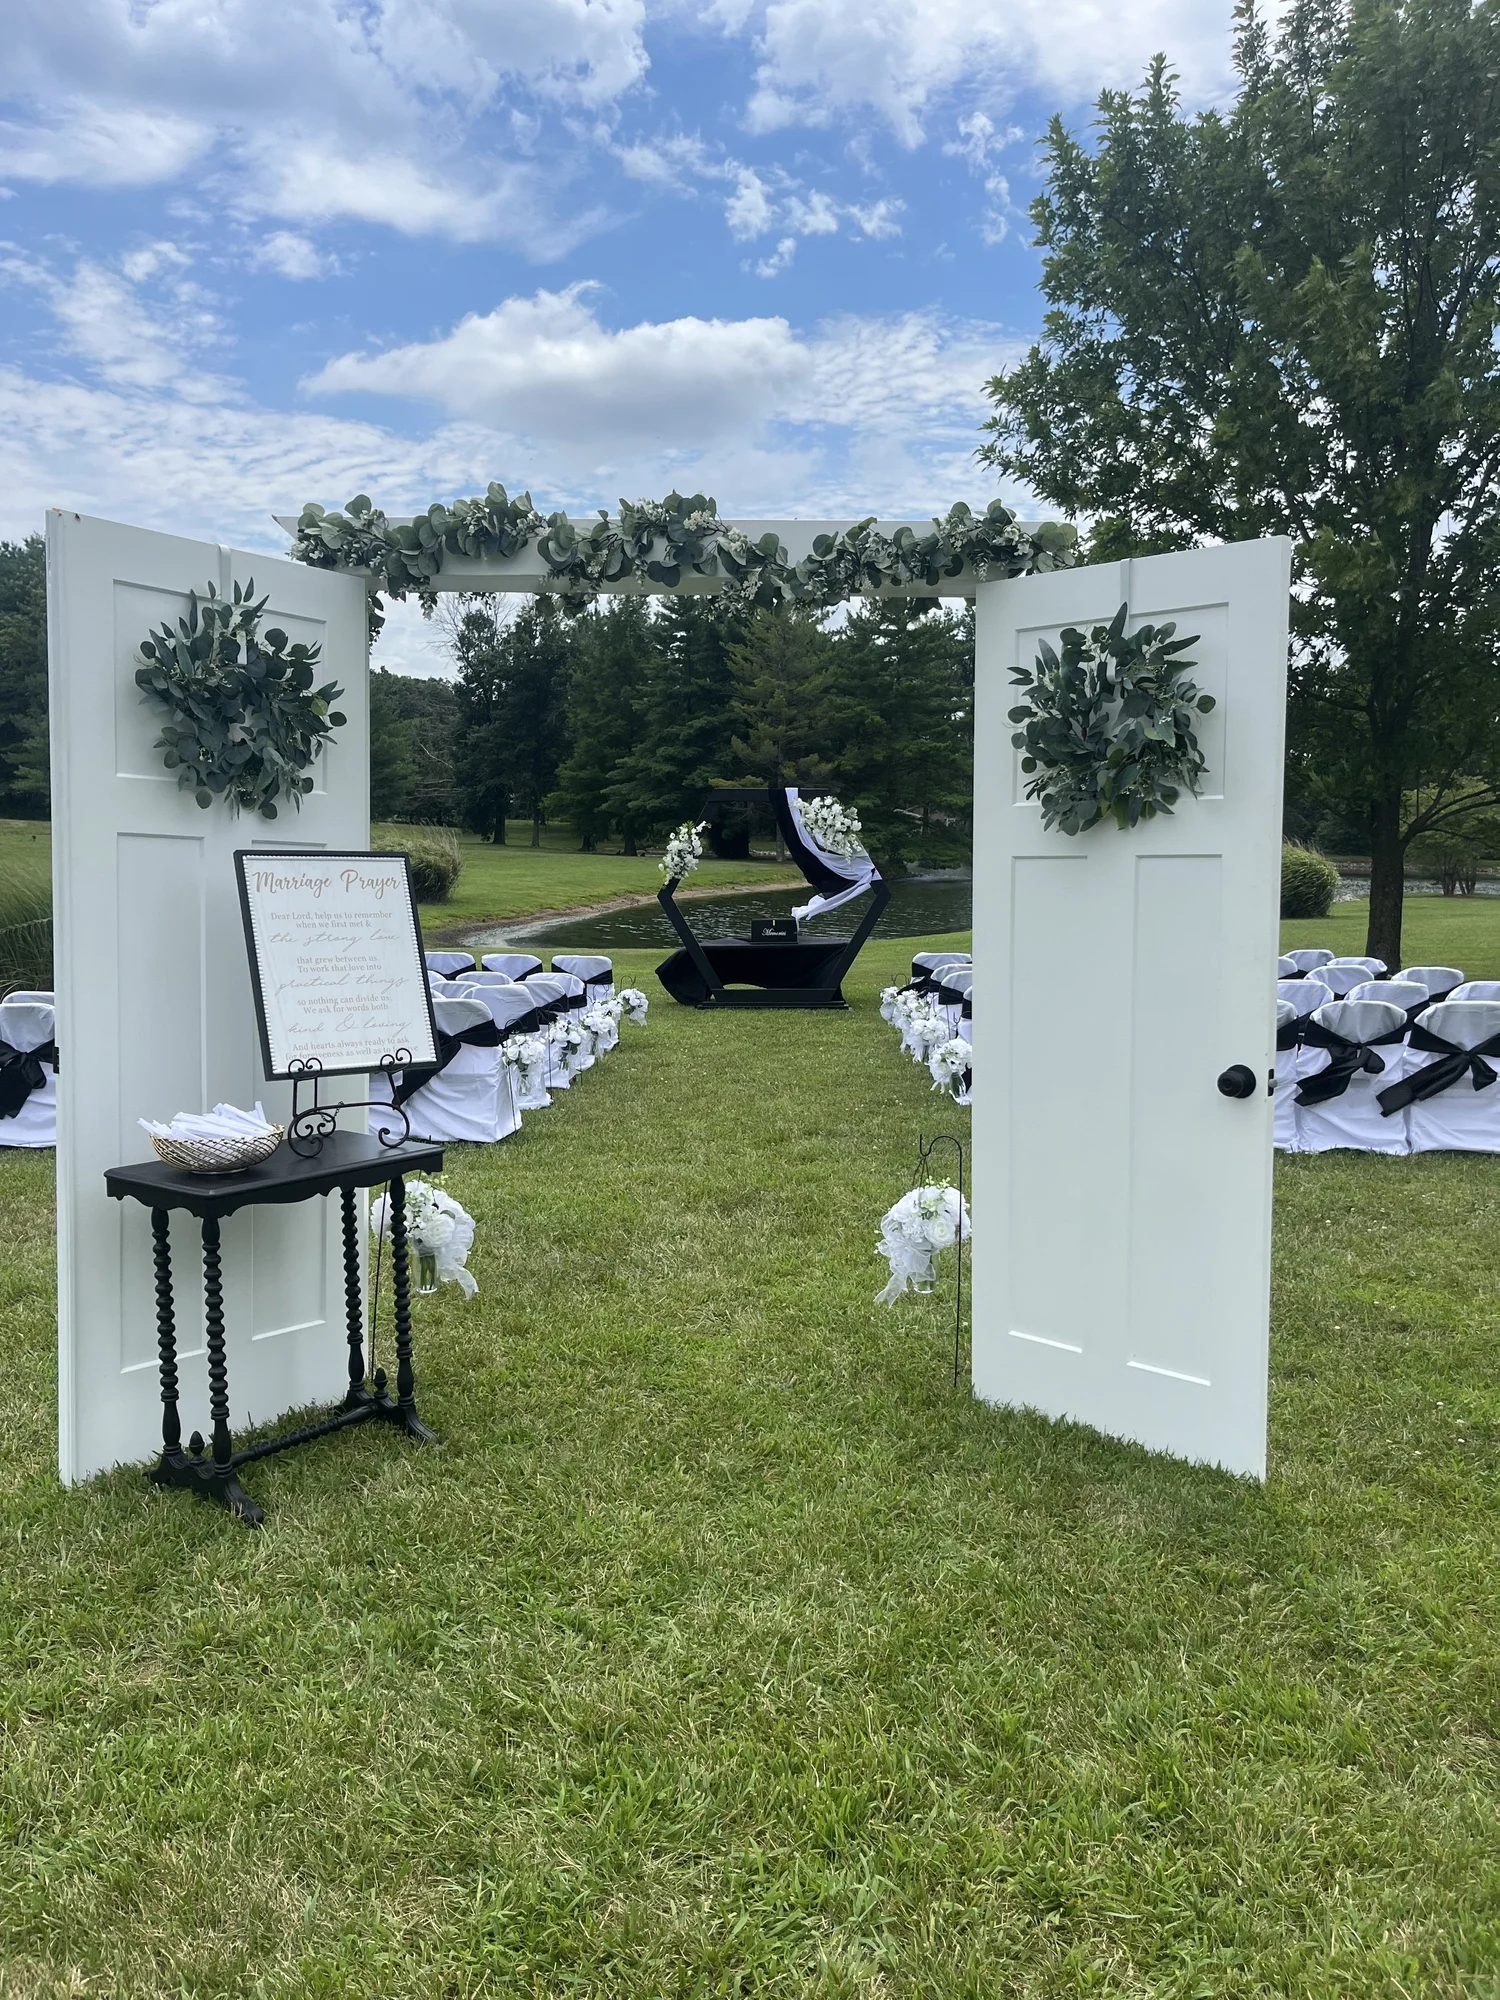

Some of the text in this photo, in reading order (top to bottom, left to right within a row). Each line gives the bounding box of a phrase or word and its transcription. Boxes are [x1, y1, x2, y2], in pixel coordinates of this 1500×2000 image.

[252, 869, 400, 900] Marriage Prayer
[292, 912, 312, 920] Lord,
[315, 912, 332, 921] help
[354, 911, 392, 919] remember
[268, 928, 400, 952] the strong love
[336, 955, 366, 963] between
[310, 965, 330, 973] work
[332, 964, 346, 972] that
[274, 974, 410, 996] practical things
[308, 996, 338, 1006] nothing
[356, 994, 378, 1002] divide
[303, 1002, 388, 1014] We ask for words both
[288, 1014, 412, 1038] kind & loving
[292, 1043, 308, 1052] And
[310, 1042, 335, 1050] hearts
[337, 1039, 362, 1049] always
[364, 1038, 385, 1046] ready
[396, 1036, 410, 1044] ask
[286, 1052, 298, 1061] for
[356, 1047, 372, 1055] well
